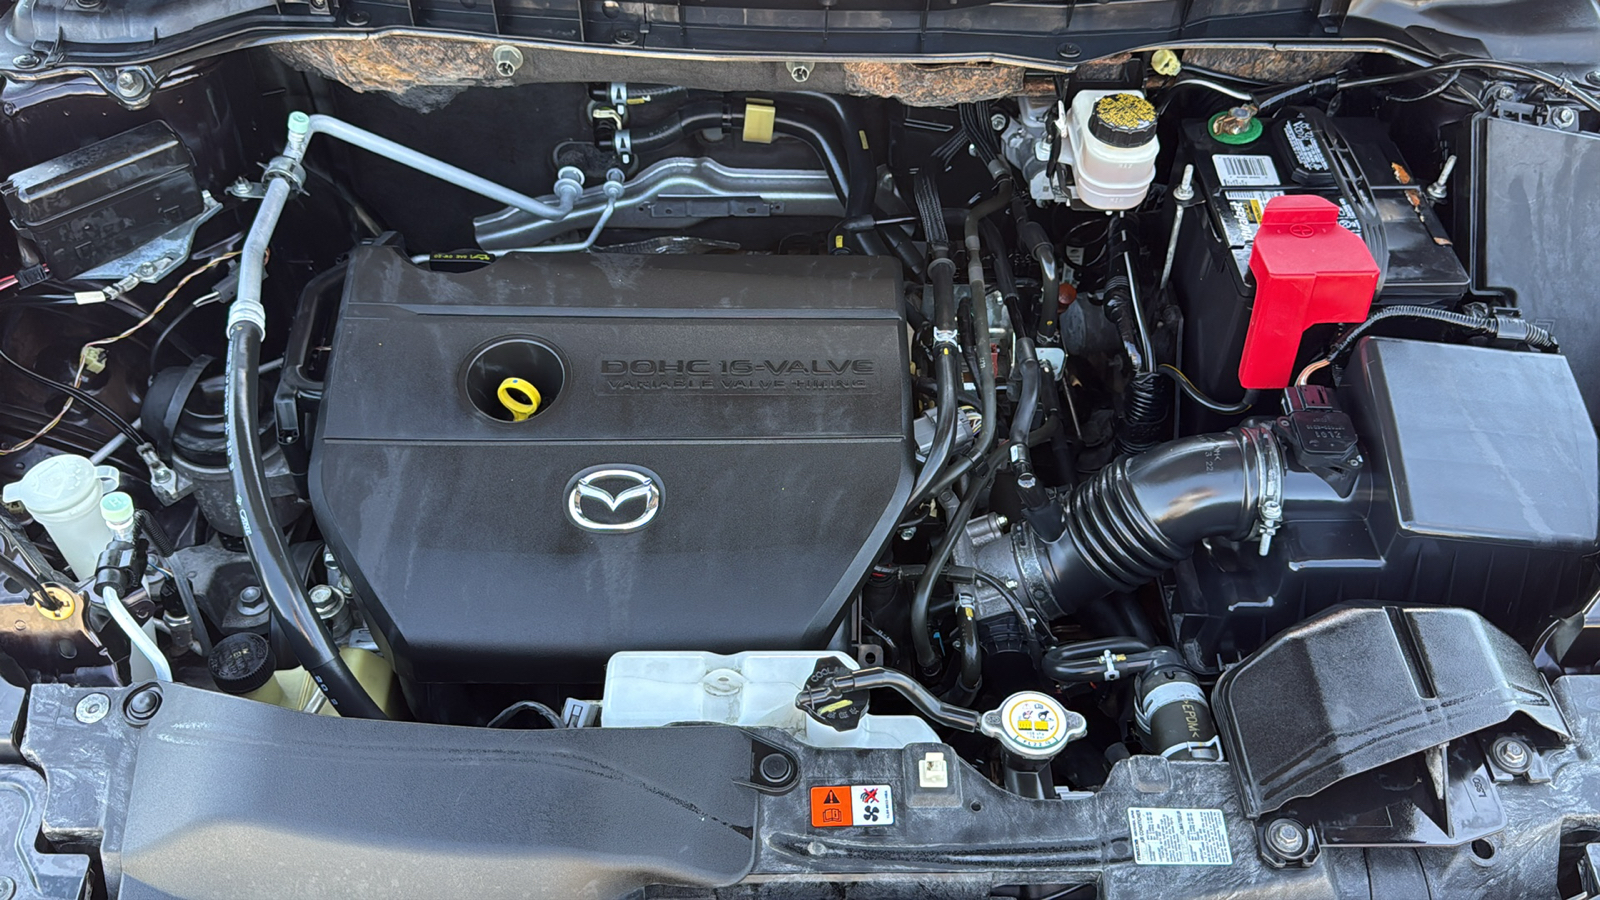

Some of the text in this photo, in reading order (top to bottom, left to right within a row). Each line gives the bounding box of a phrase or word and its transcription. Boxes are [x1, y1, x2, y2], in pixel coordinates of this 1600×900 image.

[600, 360, 875, 376] DOHC 16-VALVE
[607, 379, 867, 390] VARIABLE VALVE TIMING
